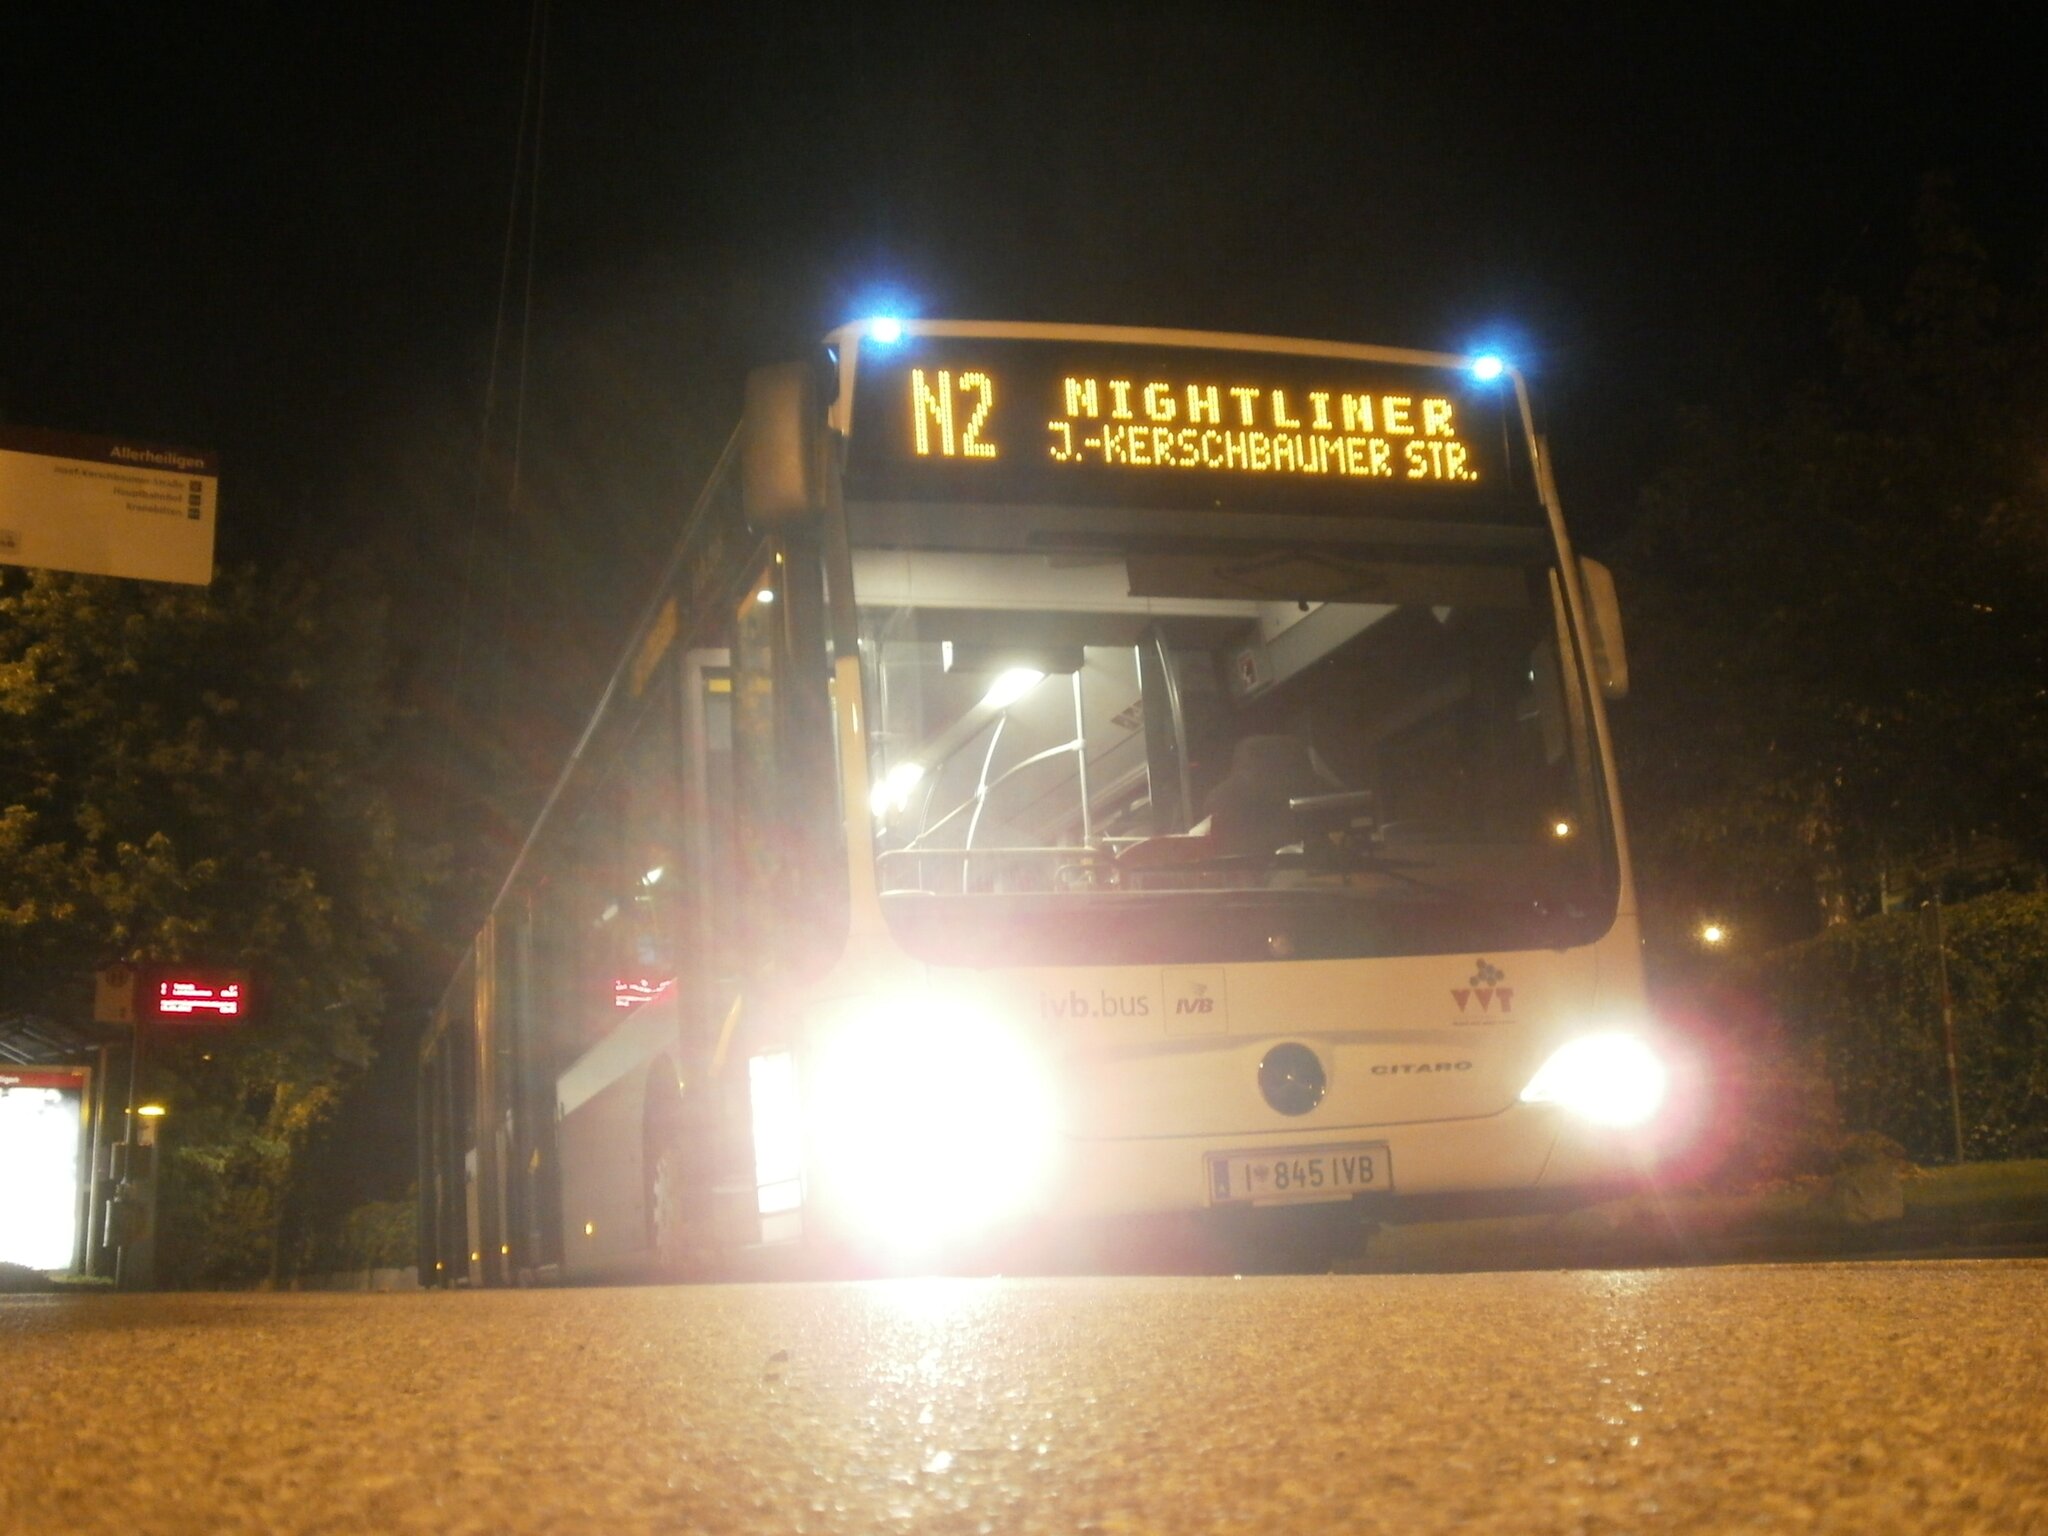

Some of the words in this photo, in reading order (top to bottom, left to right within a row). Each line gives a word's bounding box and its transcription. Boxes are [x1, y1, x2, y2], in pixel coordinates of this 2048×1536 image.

[911, 368, 996, 460] N2
[1064, 376, 1455, 437] NIGHTLINER
[109, 446, 205, 468] Allerheiligen
[1047, 420, 1393, 477] J.-KERSCHBAUMER
[1405, 439, 1478, 481] STR.
[1039, 990, 1150, 1018] ivb.bus
[1175, 997, 1214, 1015] IVB
[1450, 987, 1515, 1014] VVT
[1370, 1060, 1473, 1076] CITARO
